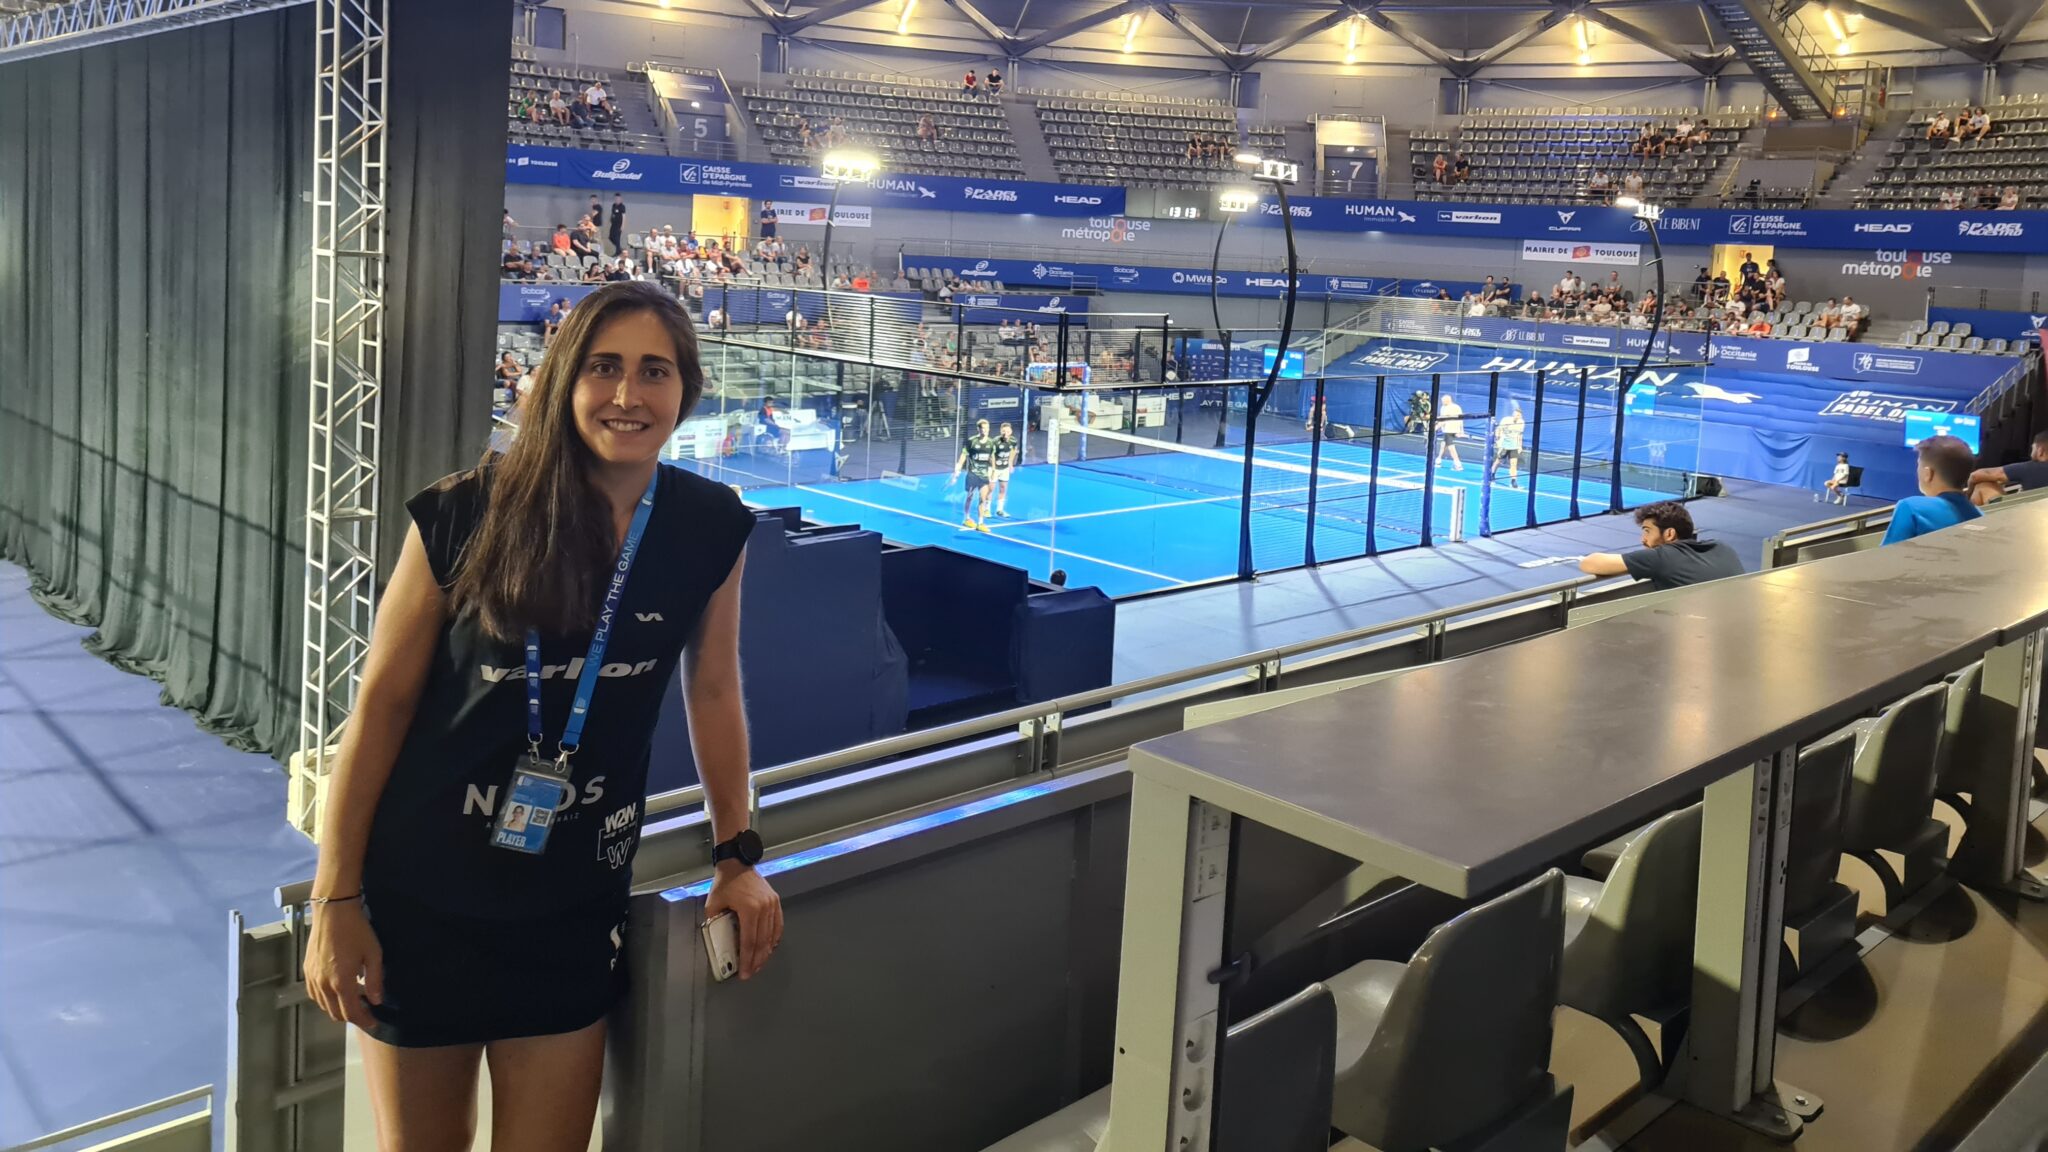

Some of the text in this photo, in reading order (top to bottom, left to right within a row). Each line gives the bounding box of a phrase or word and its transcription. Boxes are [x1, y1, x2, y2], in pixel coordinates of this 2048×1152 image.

[693, 118, 708, 138] 5
[592, 170, 643, 180] Bullpadel
[702, 165, 731, 174] CAISSE
[1350, 161, 1364, 179] 7
[866, 179, 916, 192] HUMAN
[1054, 195, 1101, 205] HEAD
[834, 211, 870, 220] OULOUSE
[1344, 205, 1395, 216] HUMAN
[1088, 215, 1151, 231] toulouse
[1671, 217, 1701, 231] BIBENT
[1753, 215, 1785, 223] CAISSE
[1854, 223, 1912, 233] HEAD
[1061, 227, 1135, 245] métropole
[1525, 246, 1638, 258] MAIRIE DE TOULOUSE
[1876, 249, 1952, 264] toulouse
[1842, 261, 1932, 280] métropole
[1245, 278, 1301, 288] HEAD
[1371, 350, 1440, 361] HUMAN
[1721, 350, 1758, 358] Occitanie
[1360, 355, 1396, 364] PADEL
[1395, 359, 1430, 369] OPEN
[1786, 364, 1820, 373] TOULOUSE
[1481, 357, 1679, 387] HUMAN
[1831, 403, 1884, 417] PADEL
[1840, 397, 1945, 412] HUMAN
[587, 531, 639, 668] WE PLAY THE GAME
[480, 657, 658, 683] varlon
[462, 775, 607, 817] NOS
[496, 831, 527, 848] PLAYER
